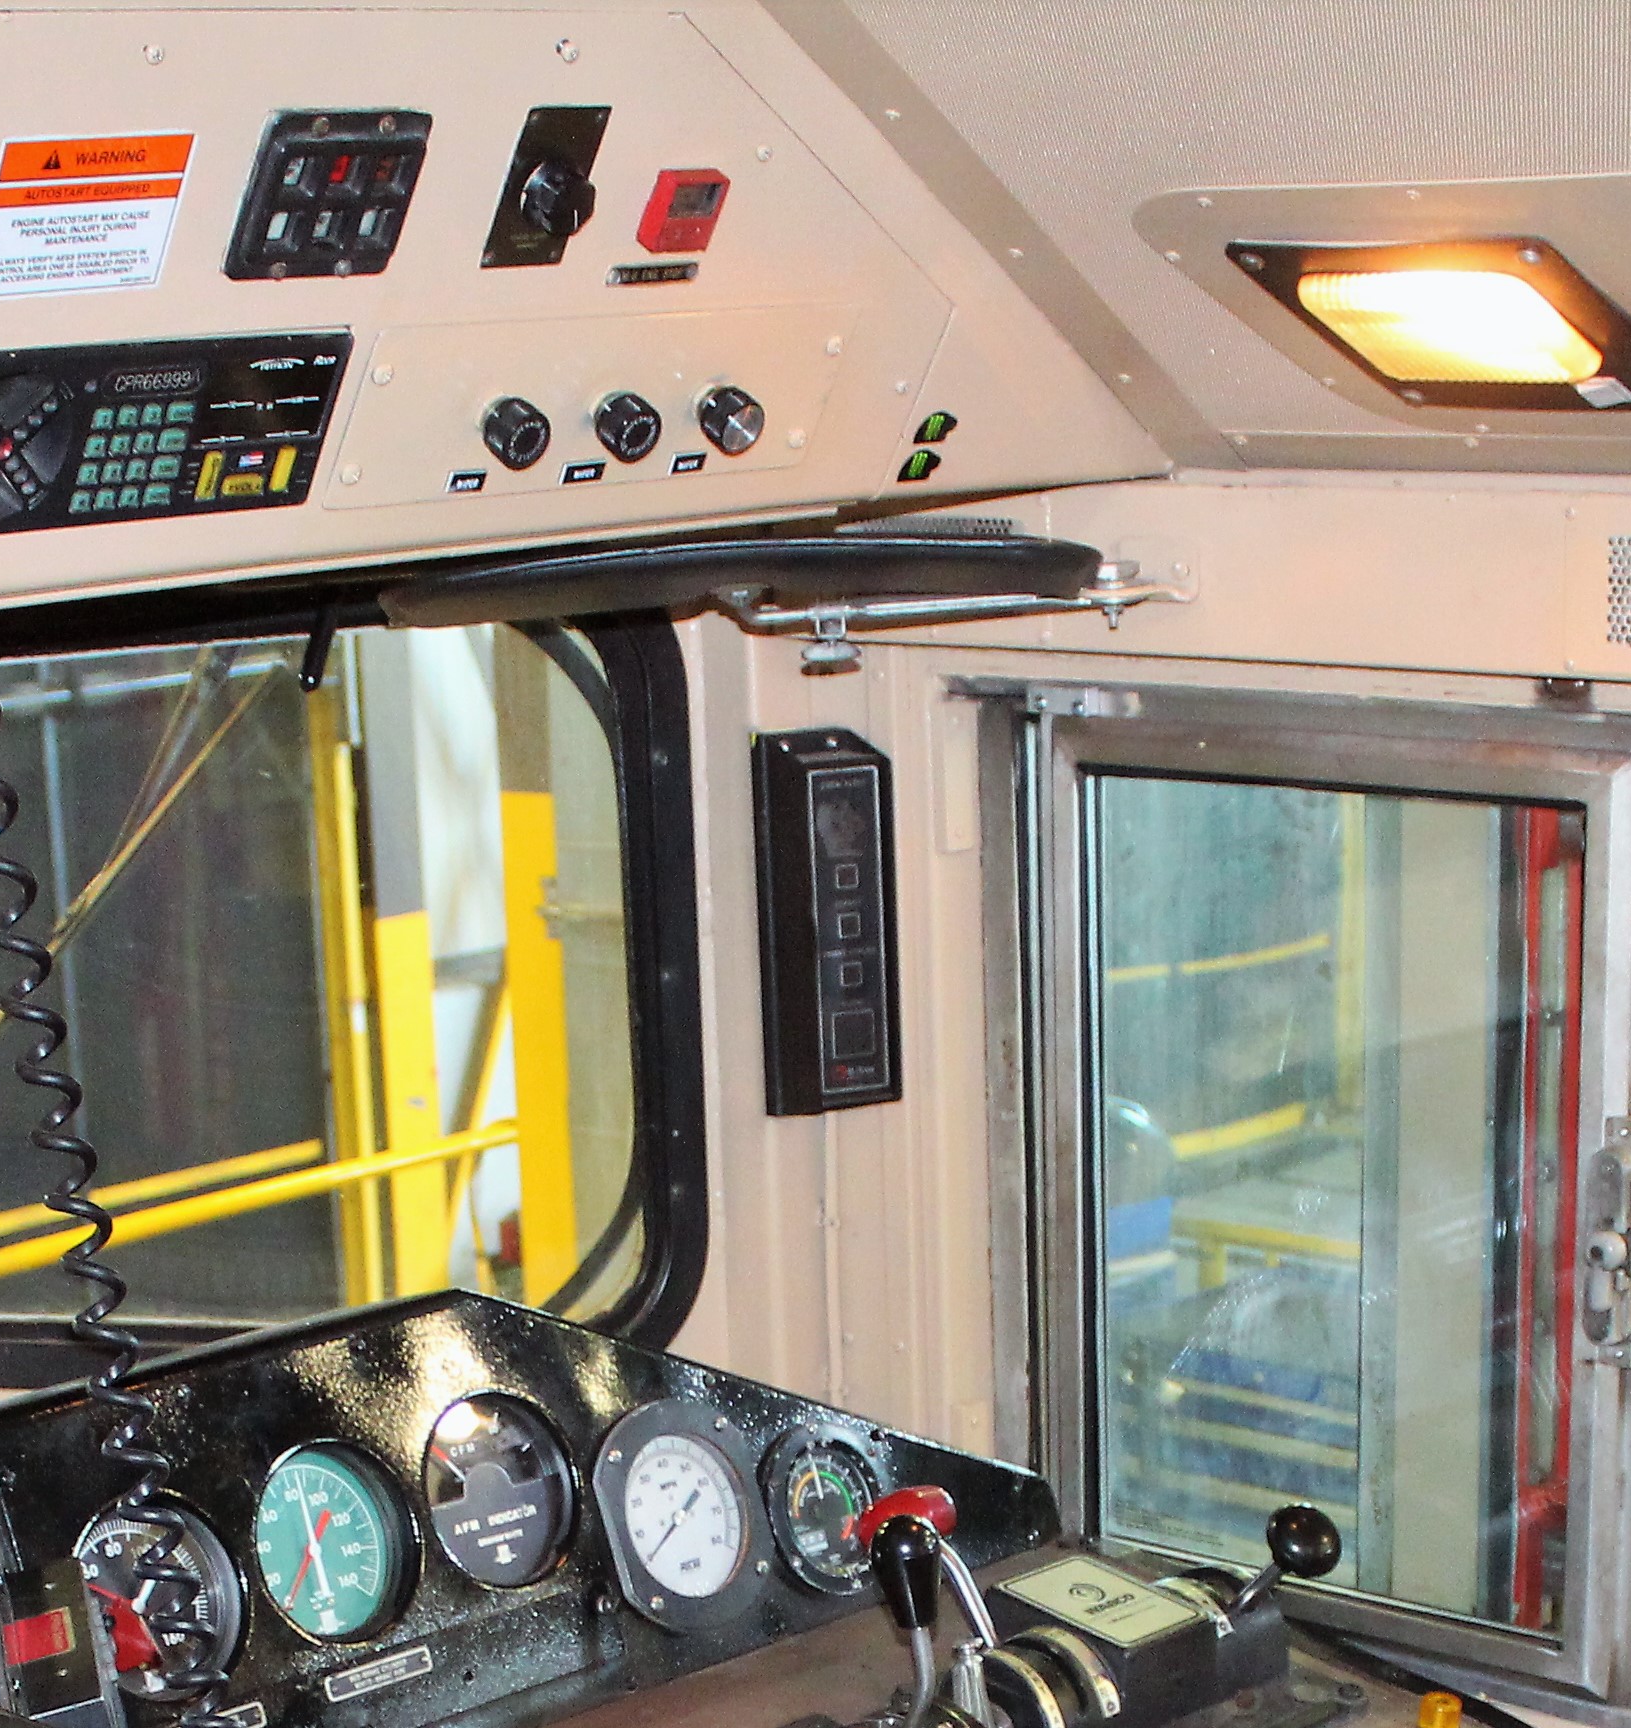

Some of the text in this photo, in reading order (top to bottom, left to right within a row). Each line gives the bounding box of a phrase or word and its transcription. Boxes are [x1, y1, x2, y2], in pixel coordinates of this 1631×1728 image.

[76, 148, 147, 167] WARNING
[24, 182, 152, 201] AUTOSTART EQUIPPED
[11, 209, 151, 228] ENGINE AUTOSTART MAY CAUSE
[19, 226, 68, 238] PERSONAL
[103, 221, 138, 232] DURING
[45, 232, 109, 245] MAINTENANCE
[308, 1491, 329, 1507] 100
[331, 1512, 351, 1527] 120
[103, 1542, 123, 1558] 80
[340, 1542, 362, 1557] 140
